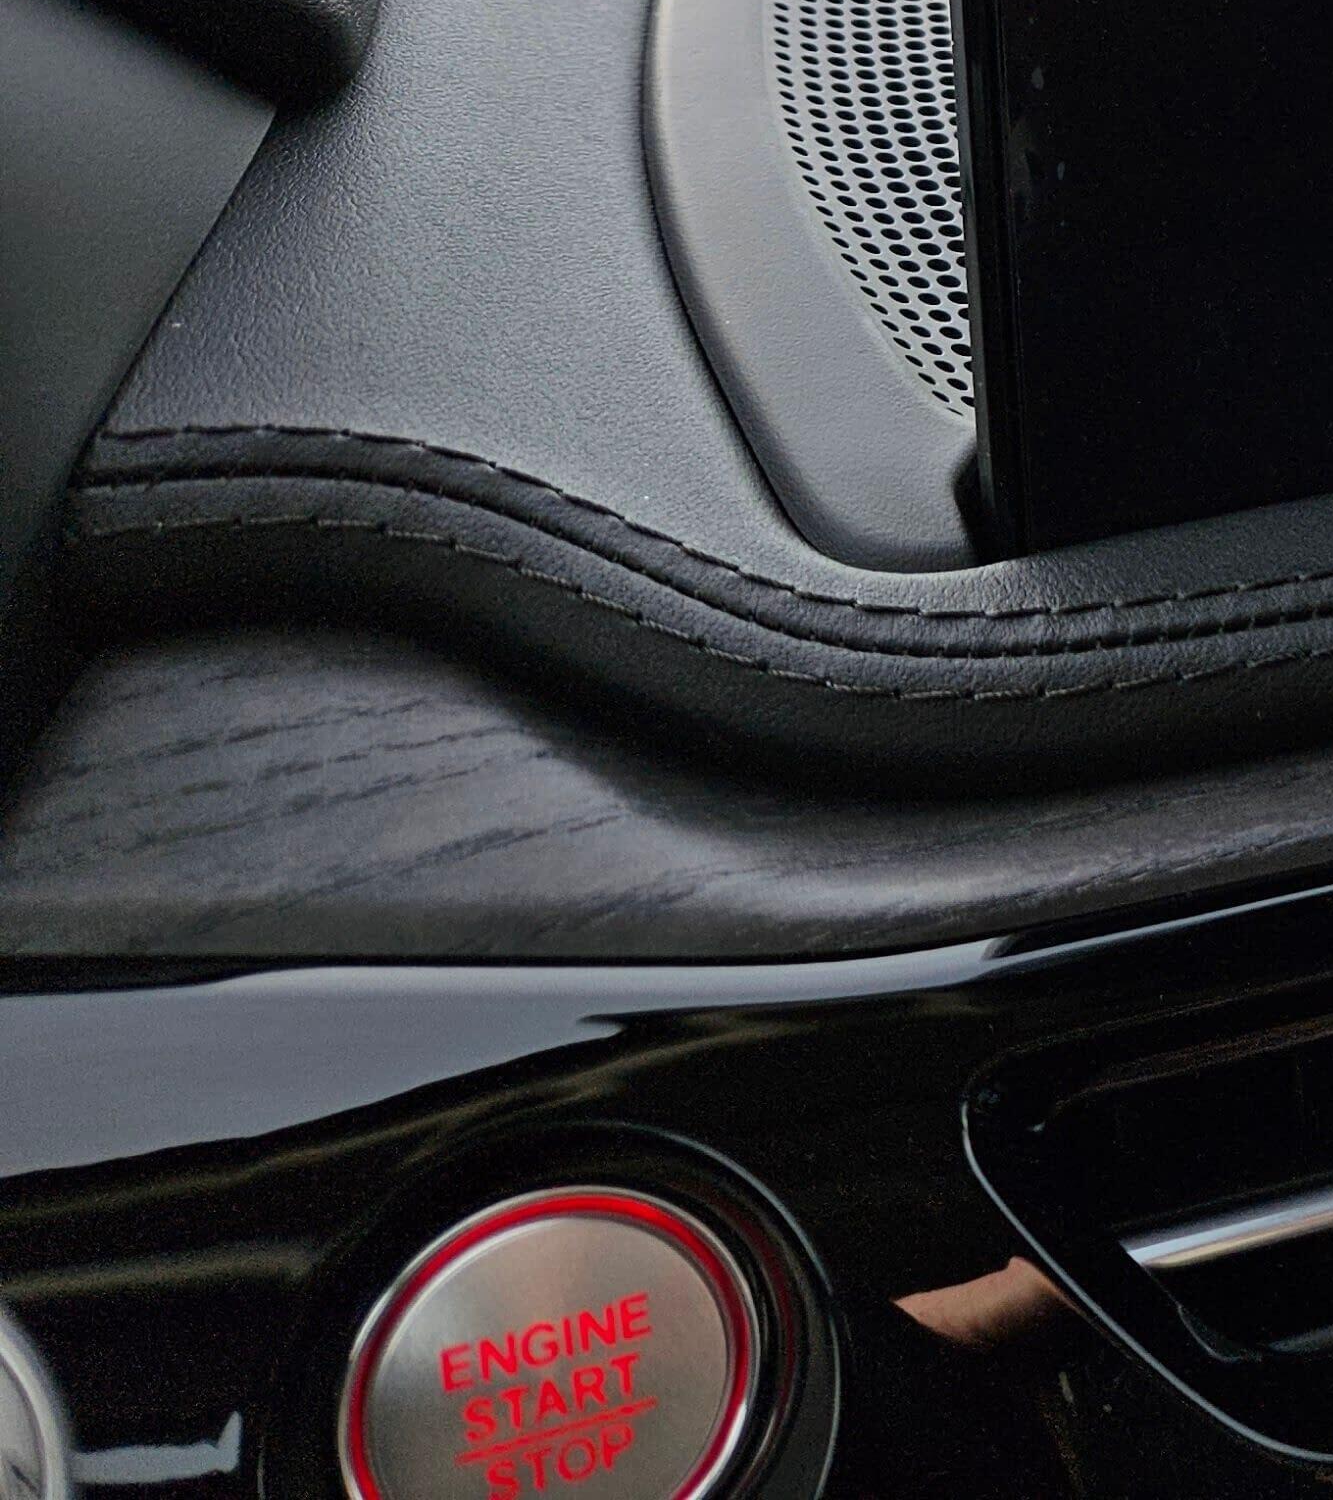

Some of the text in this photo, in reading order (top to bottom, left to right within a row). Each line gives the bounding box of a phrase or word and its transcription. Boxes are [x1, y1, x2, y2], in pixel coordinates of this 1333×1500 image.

[439, 1292, 654, 1393] ENGINE
[461, 1352, 641, 1443] START
[485, 1422, 636, 1500] STOP
